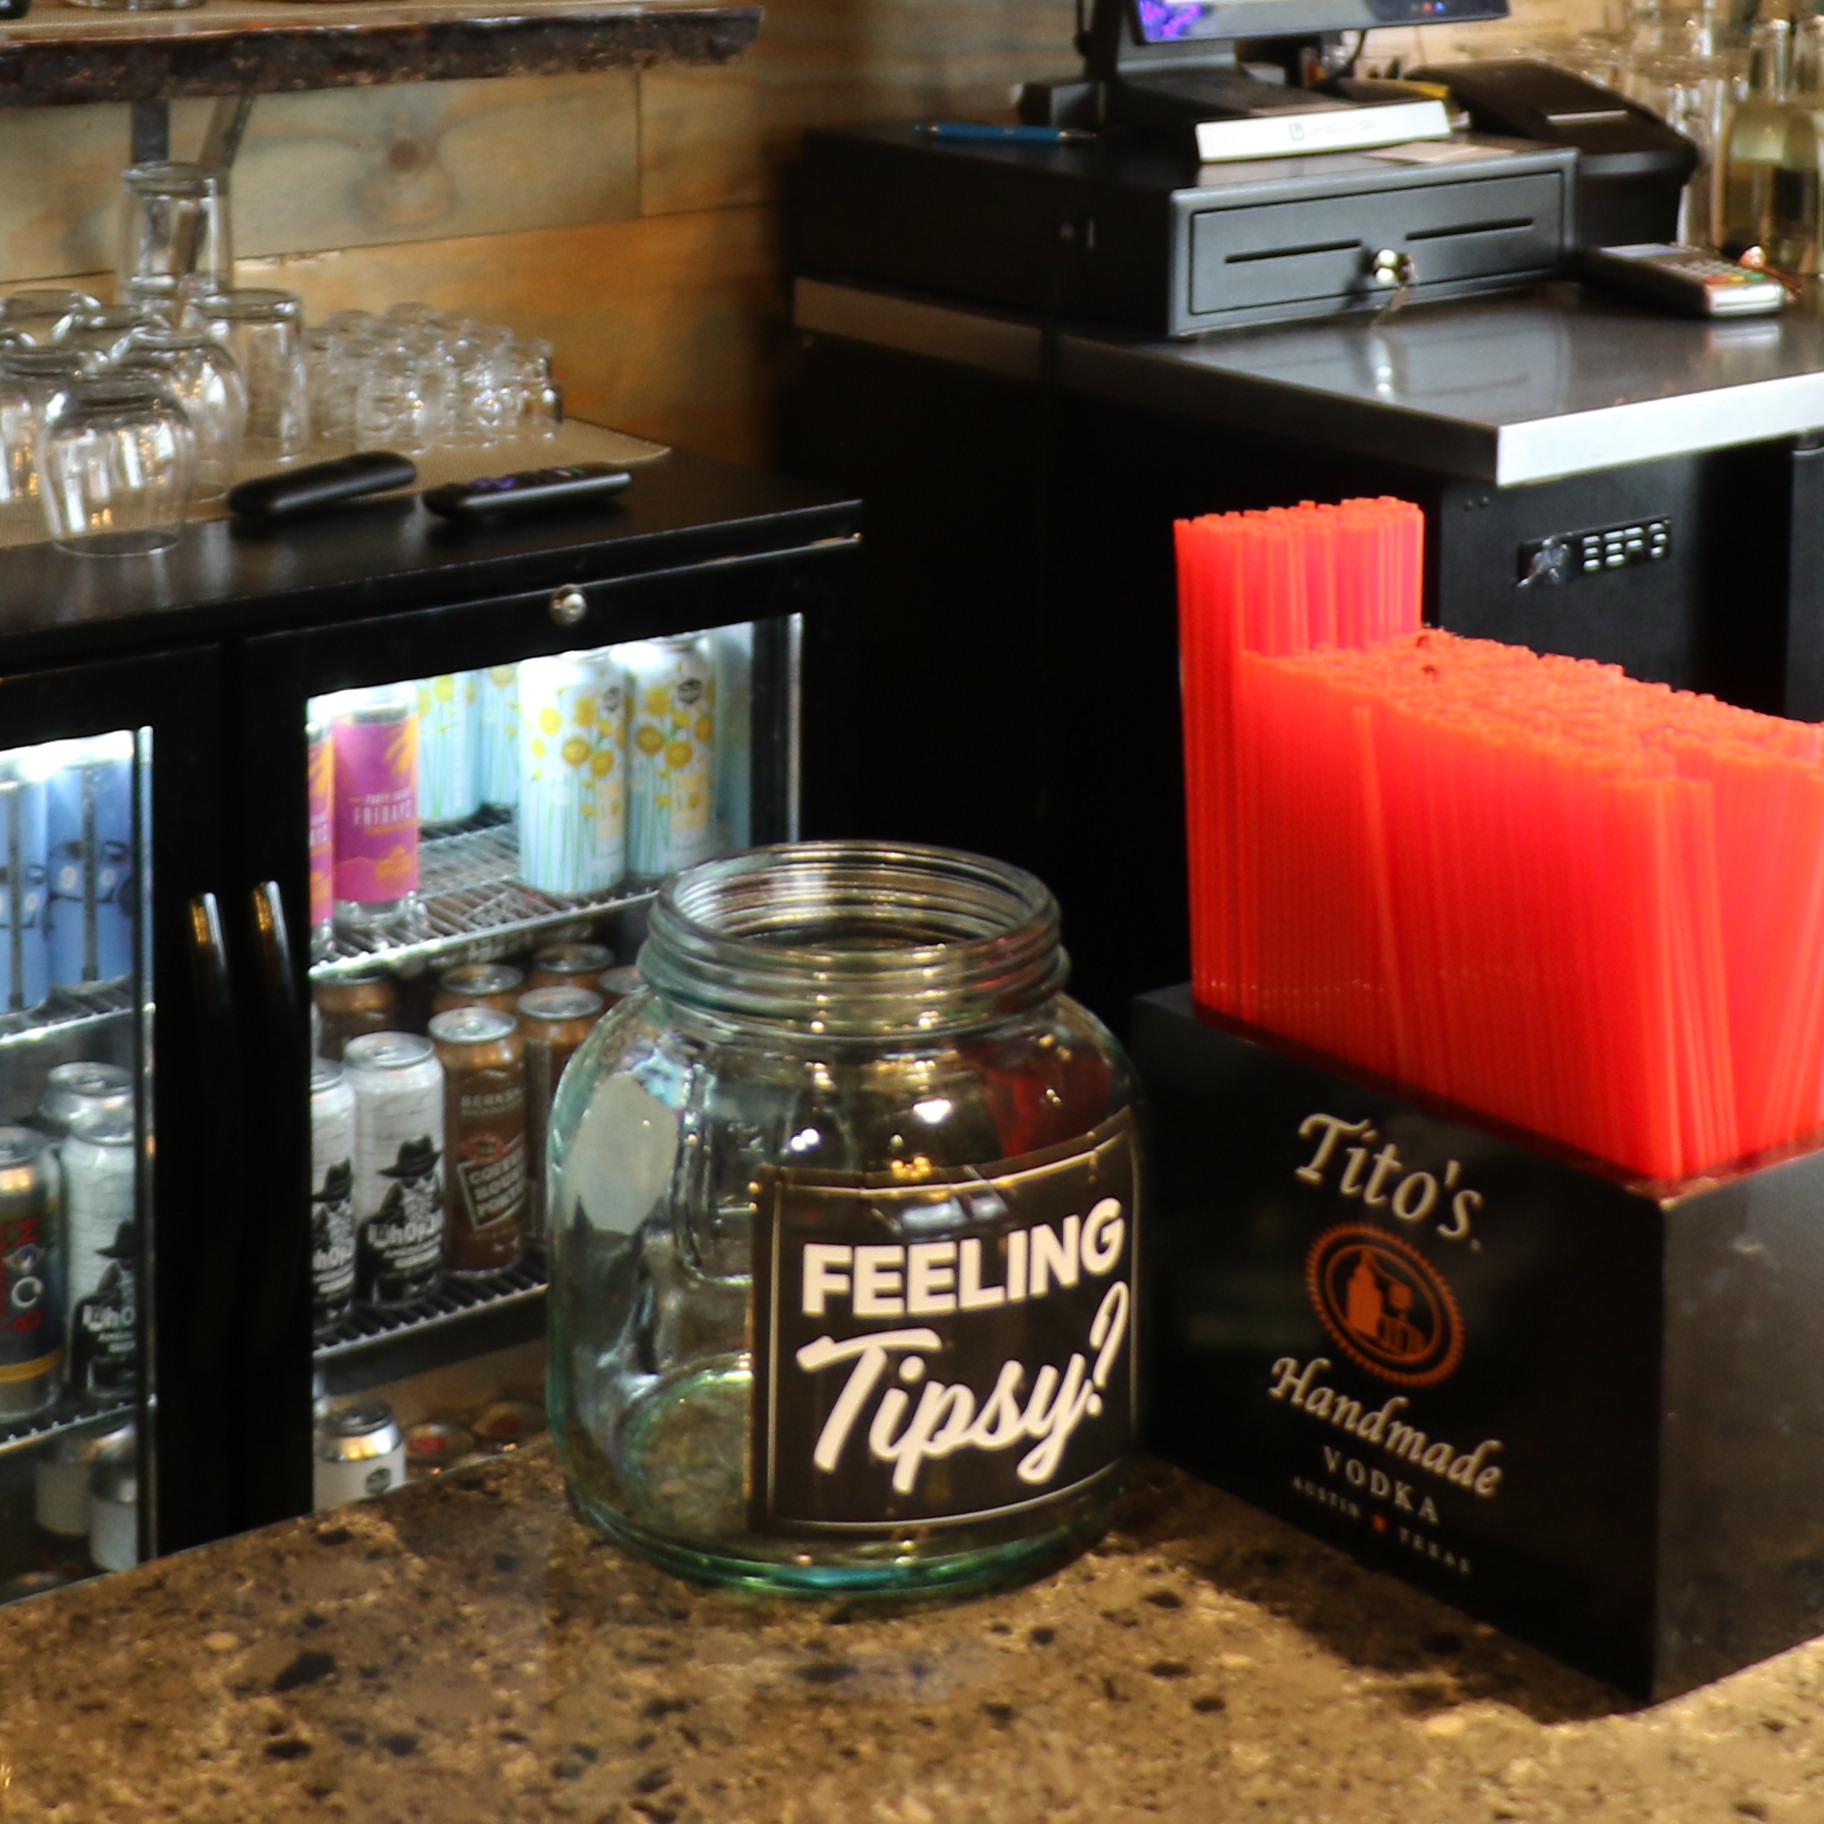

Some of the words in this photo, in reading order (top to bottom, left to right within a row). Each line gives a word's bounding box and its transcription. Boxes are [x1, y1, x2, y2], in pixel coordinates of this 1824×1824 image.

[1295, 1112, 1484, 1240] Tito's
[800, 1195, 1128, 1318] FEELING
[794, 1279, 1131, 1495] Tipsy?
[1267, 1356, 1504, 1499] Handmade
[1291, 1475, 1363, 1519] AUSTIN
[1399, 1526, 1472, 1574] TEXAS
[1322, 1445, 1440, 1525] VODKA
